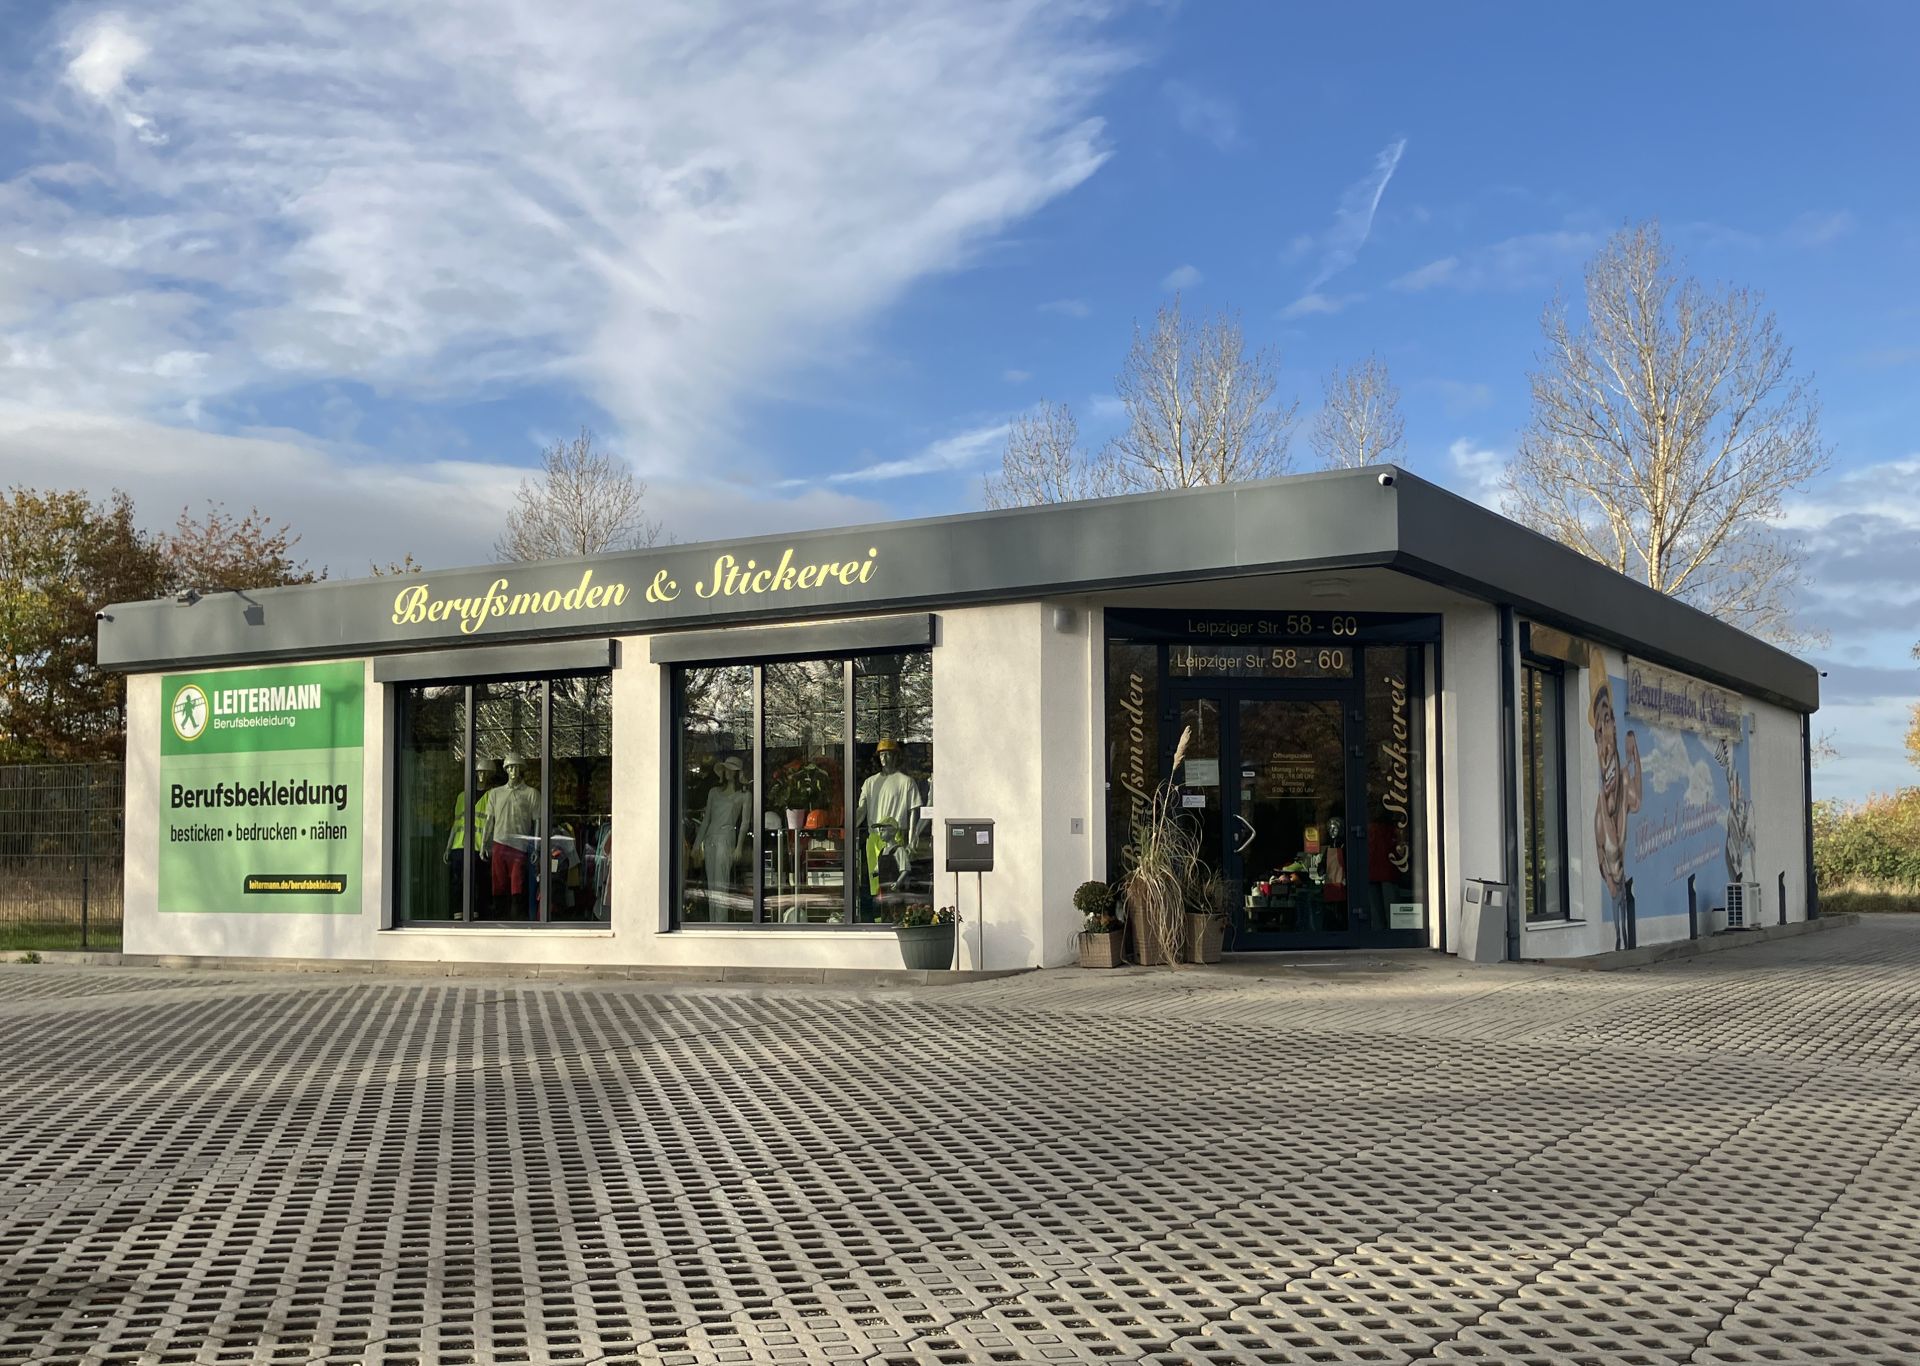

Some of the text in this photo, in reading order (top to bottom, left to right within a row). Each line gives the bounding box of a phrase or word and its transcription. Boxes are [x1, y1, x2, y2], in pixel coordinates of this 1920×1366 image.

[391, 547, 879, 635] Berufsmoden & Stickerei
[1188, 619, 1254, 637] Leipziger
[1257, 619, 1282, 635] Str.
[1286, 614, 1312, 635] 58
[1331, 615, 1357, 636] 60
[1177, 653, 1242, 671] Leipziger
[1245, 654, 1269, 669] Str.
[1271, 649, 1297, 669] 58
[1318, 650, 1344, 670] 60
[213, 684, 321, 715] LEITERMANN
[214, 715, 296, 729] Berufsbekleidung
[1382, 676, 1409, 873] & Stickerei
[171, 779, 348, 811] Berufsbekleidung
[170, 821, 347, 842] besticken bedrucken nähen
